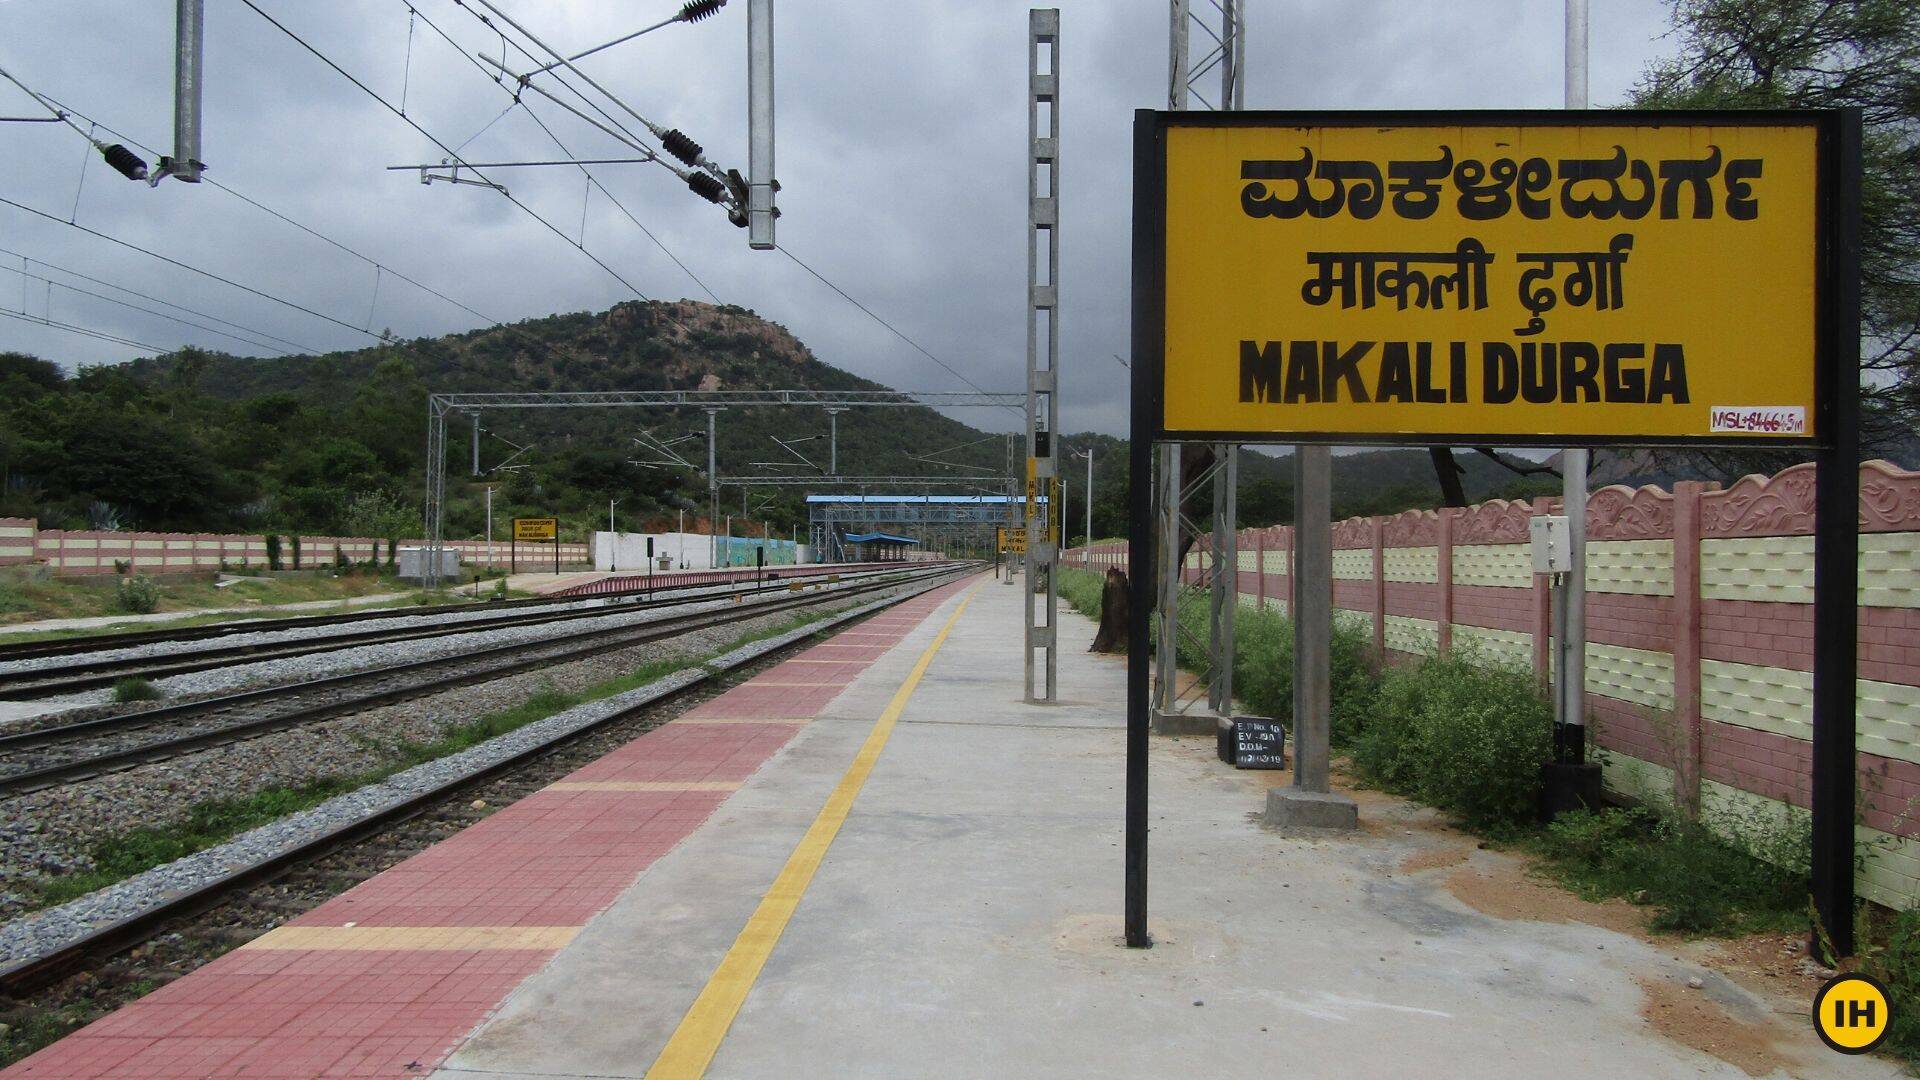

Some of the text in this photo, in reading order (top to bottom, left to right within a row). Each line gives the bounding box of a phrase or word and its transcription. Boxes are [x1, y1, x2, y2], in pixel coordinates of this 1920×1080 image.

[1301, 237, 1496, 312] माकली
[1239, 339, 1691, 405] MAKALI DURGA
